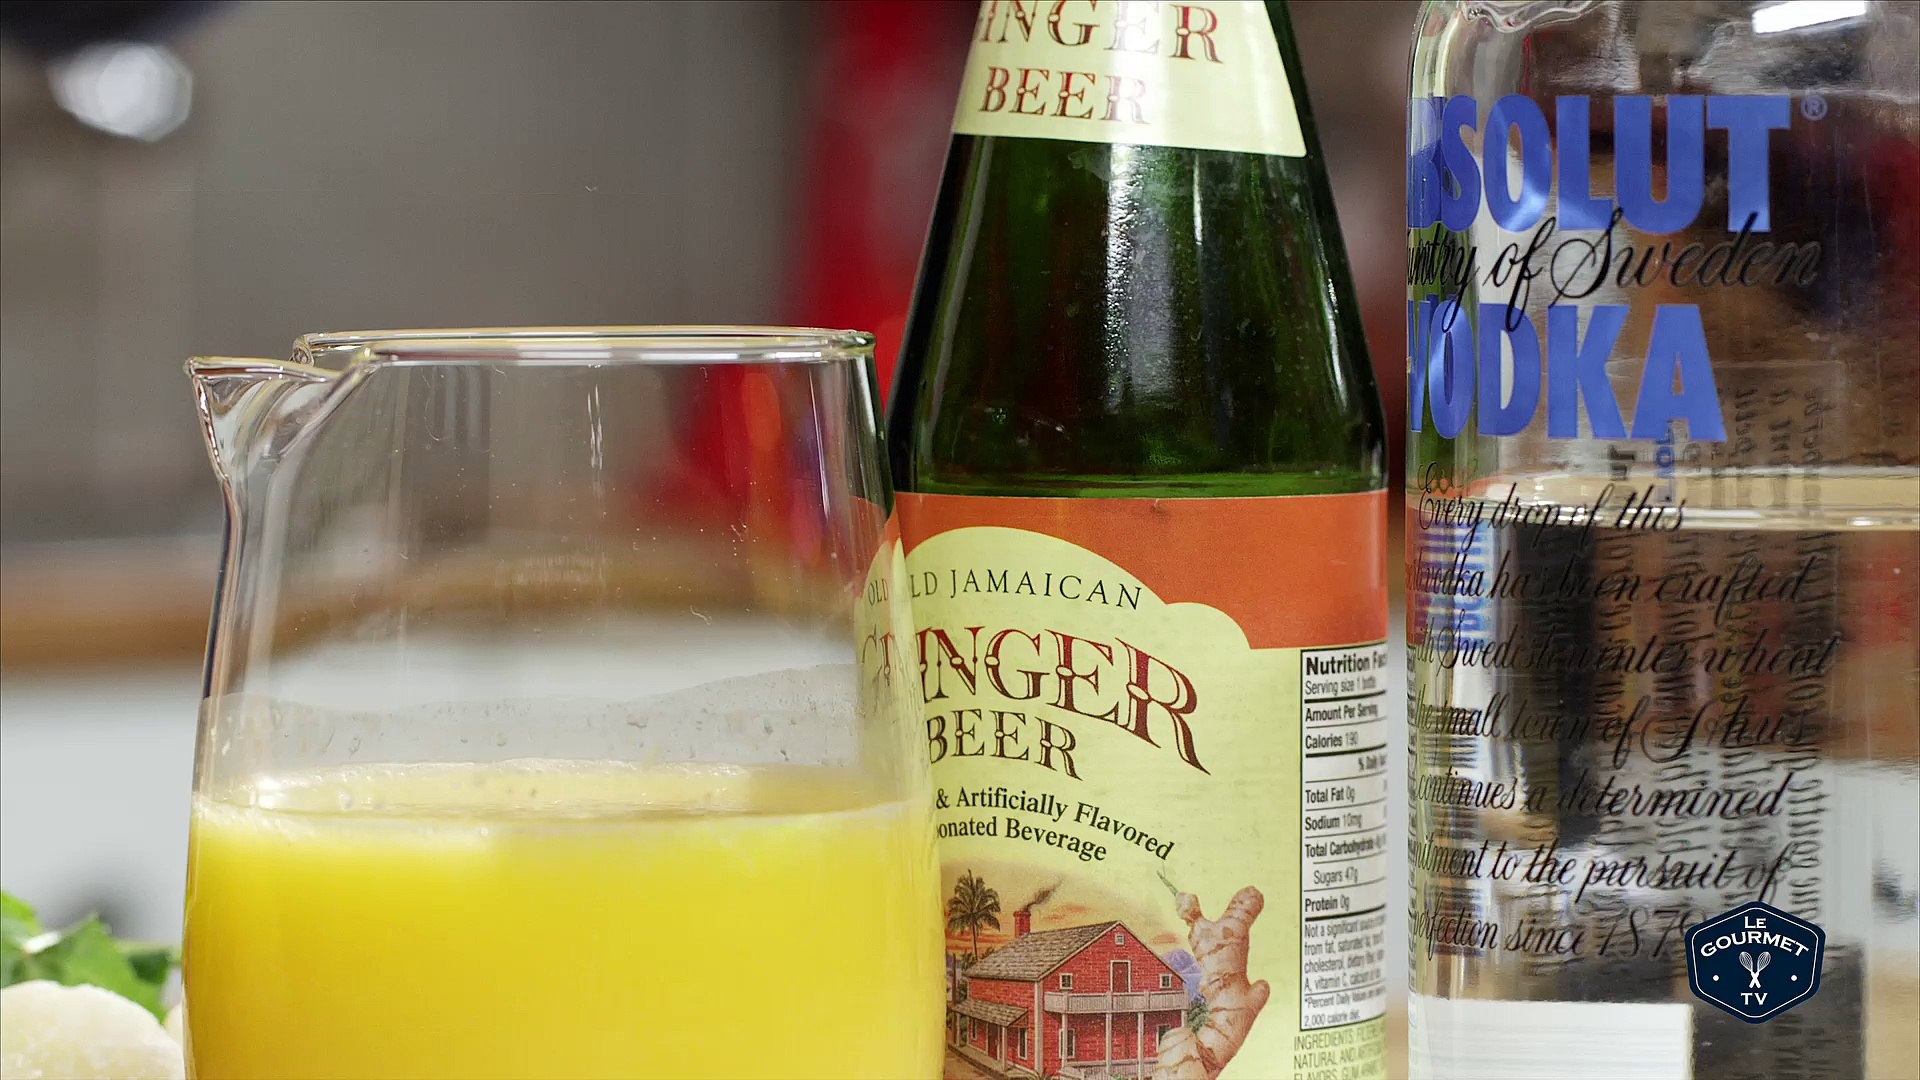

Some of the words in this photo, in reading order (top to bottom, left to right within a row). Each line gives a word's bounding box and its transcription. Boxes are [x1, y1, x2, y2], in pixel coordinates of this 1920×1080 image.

[979, 66, 1151, 124] BEER
[1482, 216, 1556, 332] of
[1549, 206, 1822, 309] Sweden
[1407, 299, 1728, 442] VODKA
[1418, 462, 1486, 551] Every
[1488, 482, 1562, 548] drop
[1568, 483, 1615, 545] of
[1614, 484, 1687, 532] this
[950, 568, 1142, 610] JAMAICAN
[1425, 552, 1485, 597] vodka
[1487, 550, 1548, 599] has
[1559, 553, 1642, 600] been
[1650, 556, 1817, 626] crafted
[1436, 609, 1557, 676] Swedish
[1704, 628, 1842, 673] wheat
[1306, 653, 1370, 675] Nutrition
[1305, 680, 1338, 696] Serving
[1341, 679, 1355, 692] size
[1305, 706, 1342, 722] Amount
[1344, 704, 1355, 719] Per
[926, 708, 1083, 782] BEER
[1305, 733, 1342, 749] Calories
[1601, 695, 1651, 770] of
[1305, 788, 1328, 803] Total
[1331, 787, 1344, 801] Fat
[1417, 765, 1518, 810] continues
[1520, 785, 1548, 812] a
[1558, 767, 1795, 818] determined
[936, 788, 950, 809] &
[956, 786, 1068, 823] Artificially
[1073, 801, 1175, 860] Flavored
[936, 816, 998, 838] onated
[1004, 817, 1107, 862] Beverage
[1305, 815, 1340, 831] Sodium
[1305, 842, 1327, 858] Total
[1314, 869, 1343, 886] Sugars
[1488, 840, 1524, 881] to
[1520, 838, 1577, 885] the
[1574, 850, 1738, 904] pursuit
[1305, 896, 1338, 912] Protein
[1304, 942, 1323, 956] from
[1305, 924, 1318, 938] Not
[1505, 919, 1586, 955] since
[1304, 1015, 1325, 1027] 2,000
[1294, 1051, 1337, 1070] NATURAL
